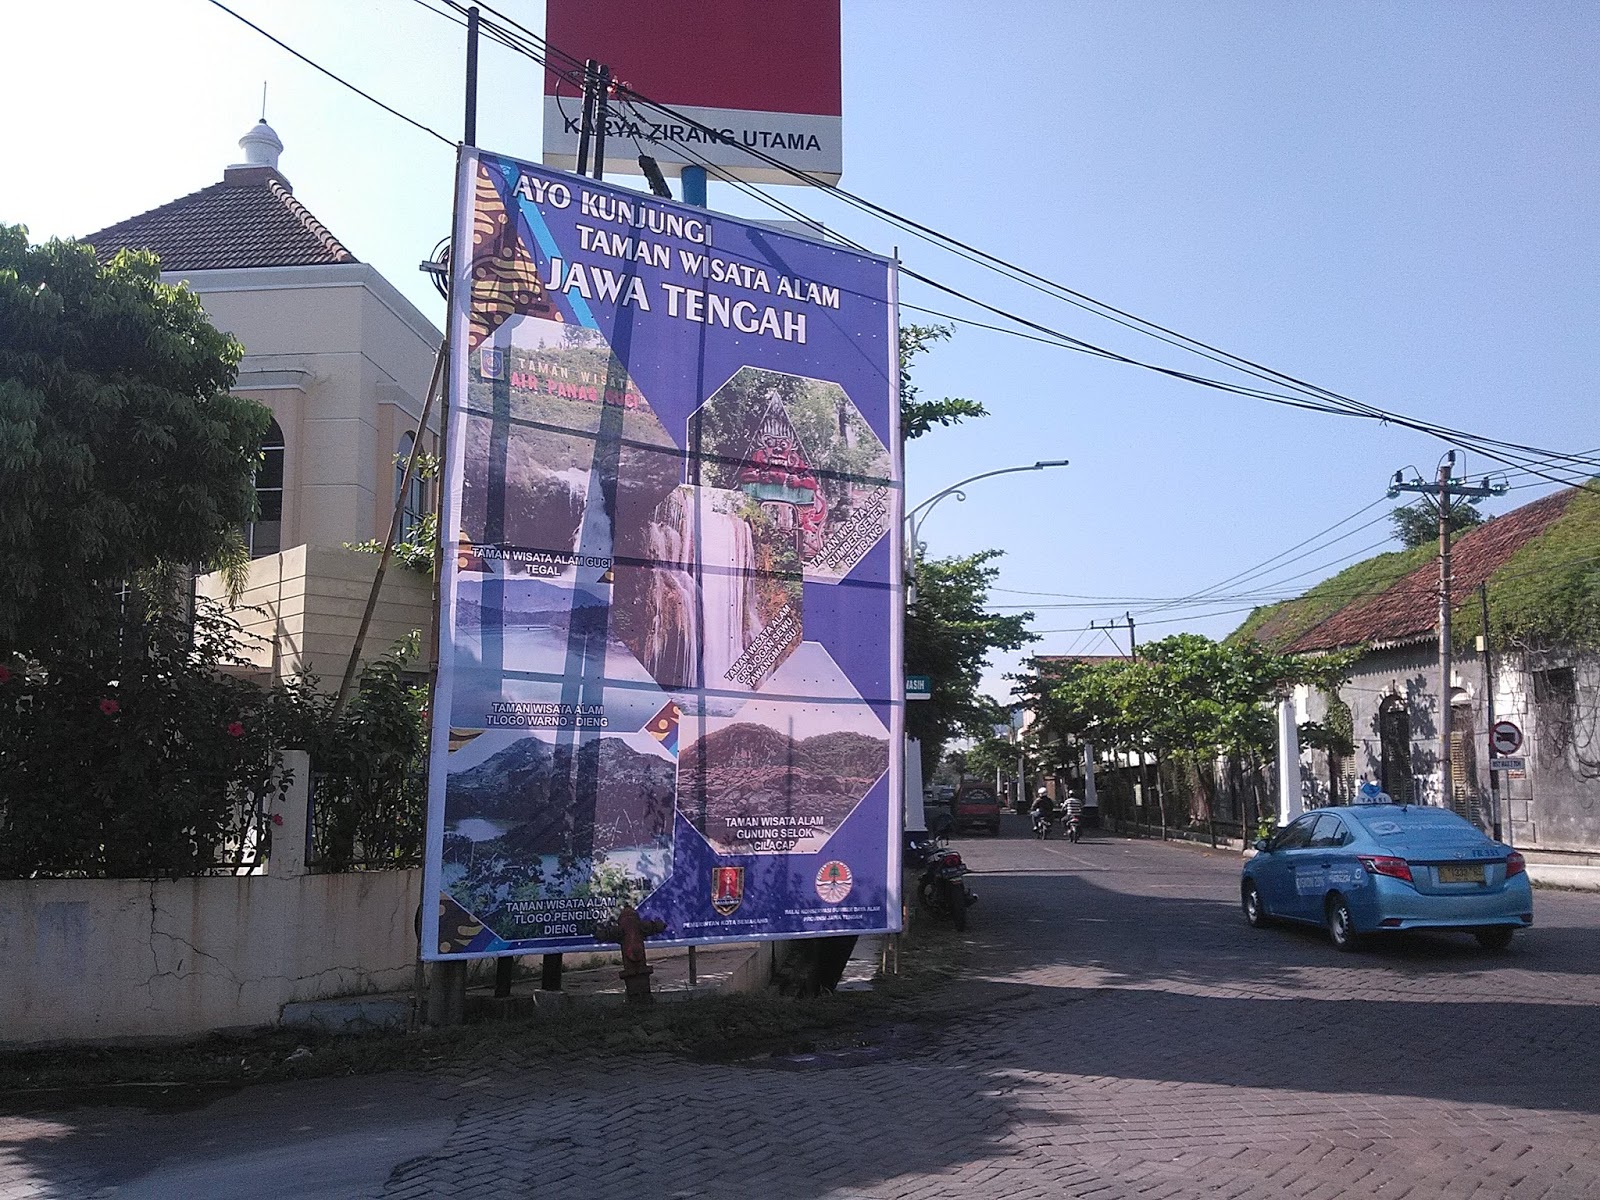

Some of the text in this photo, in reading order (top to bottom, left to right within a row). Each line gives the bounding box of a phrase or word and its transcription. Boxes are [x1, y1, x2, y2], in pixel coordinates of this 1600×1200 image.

[650, 123, 735, 146] ZIRANG
[742, 130, 822, 152] UTAMA
[512, 174, 712, 246] AYO KUNJUNGI
[576, 225, 841, 310] TAMAN WISATA ALAM
[544, 257, 807, 344] JAWA TENGAH
[518, 357, 634, 391] TAMAN WISATA
[511, 371, 639, 409] AIR PANAS GUCI
[811, 486, 888, 568] TAMAN WISATA ALAM
[827, 503, 886, 568] SUMBER SEMEN
[472, 547, 612, 568] TAMAN WISATA ALAM GUCI
[844, 524, 883, 567] REMBANG
[525, 564, 561, 576] TEGAL
[724, 604, 791, 681] TAMAN WISATA ALAM
[737, 617, 793, 683] GROJOGAN SEWU
[746, 628, 796, 688] TAWANGMANGU
[486, 714, 525, 726] TLOGO
[527, 715, 568, 726] WARNO
[576, 716, 608, 727] DIENG
[492, 702, 604, 715] TAMAN WISATA ALAM
[725, 815, 824, 827] TAMAN WISATA ALAM
[736, 828, 812, 839] GUNUNG SELOK
[753, 840, 795, 851] CILACAP
[506, 897, 616, 912] TAMAN WISATA ALAM
[514, 909, 608, 924] TLOGO PENGILON
[544, 924, 577, 935] DIENG
